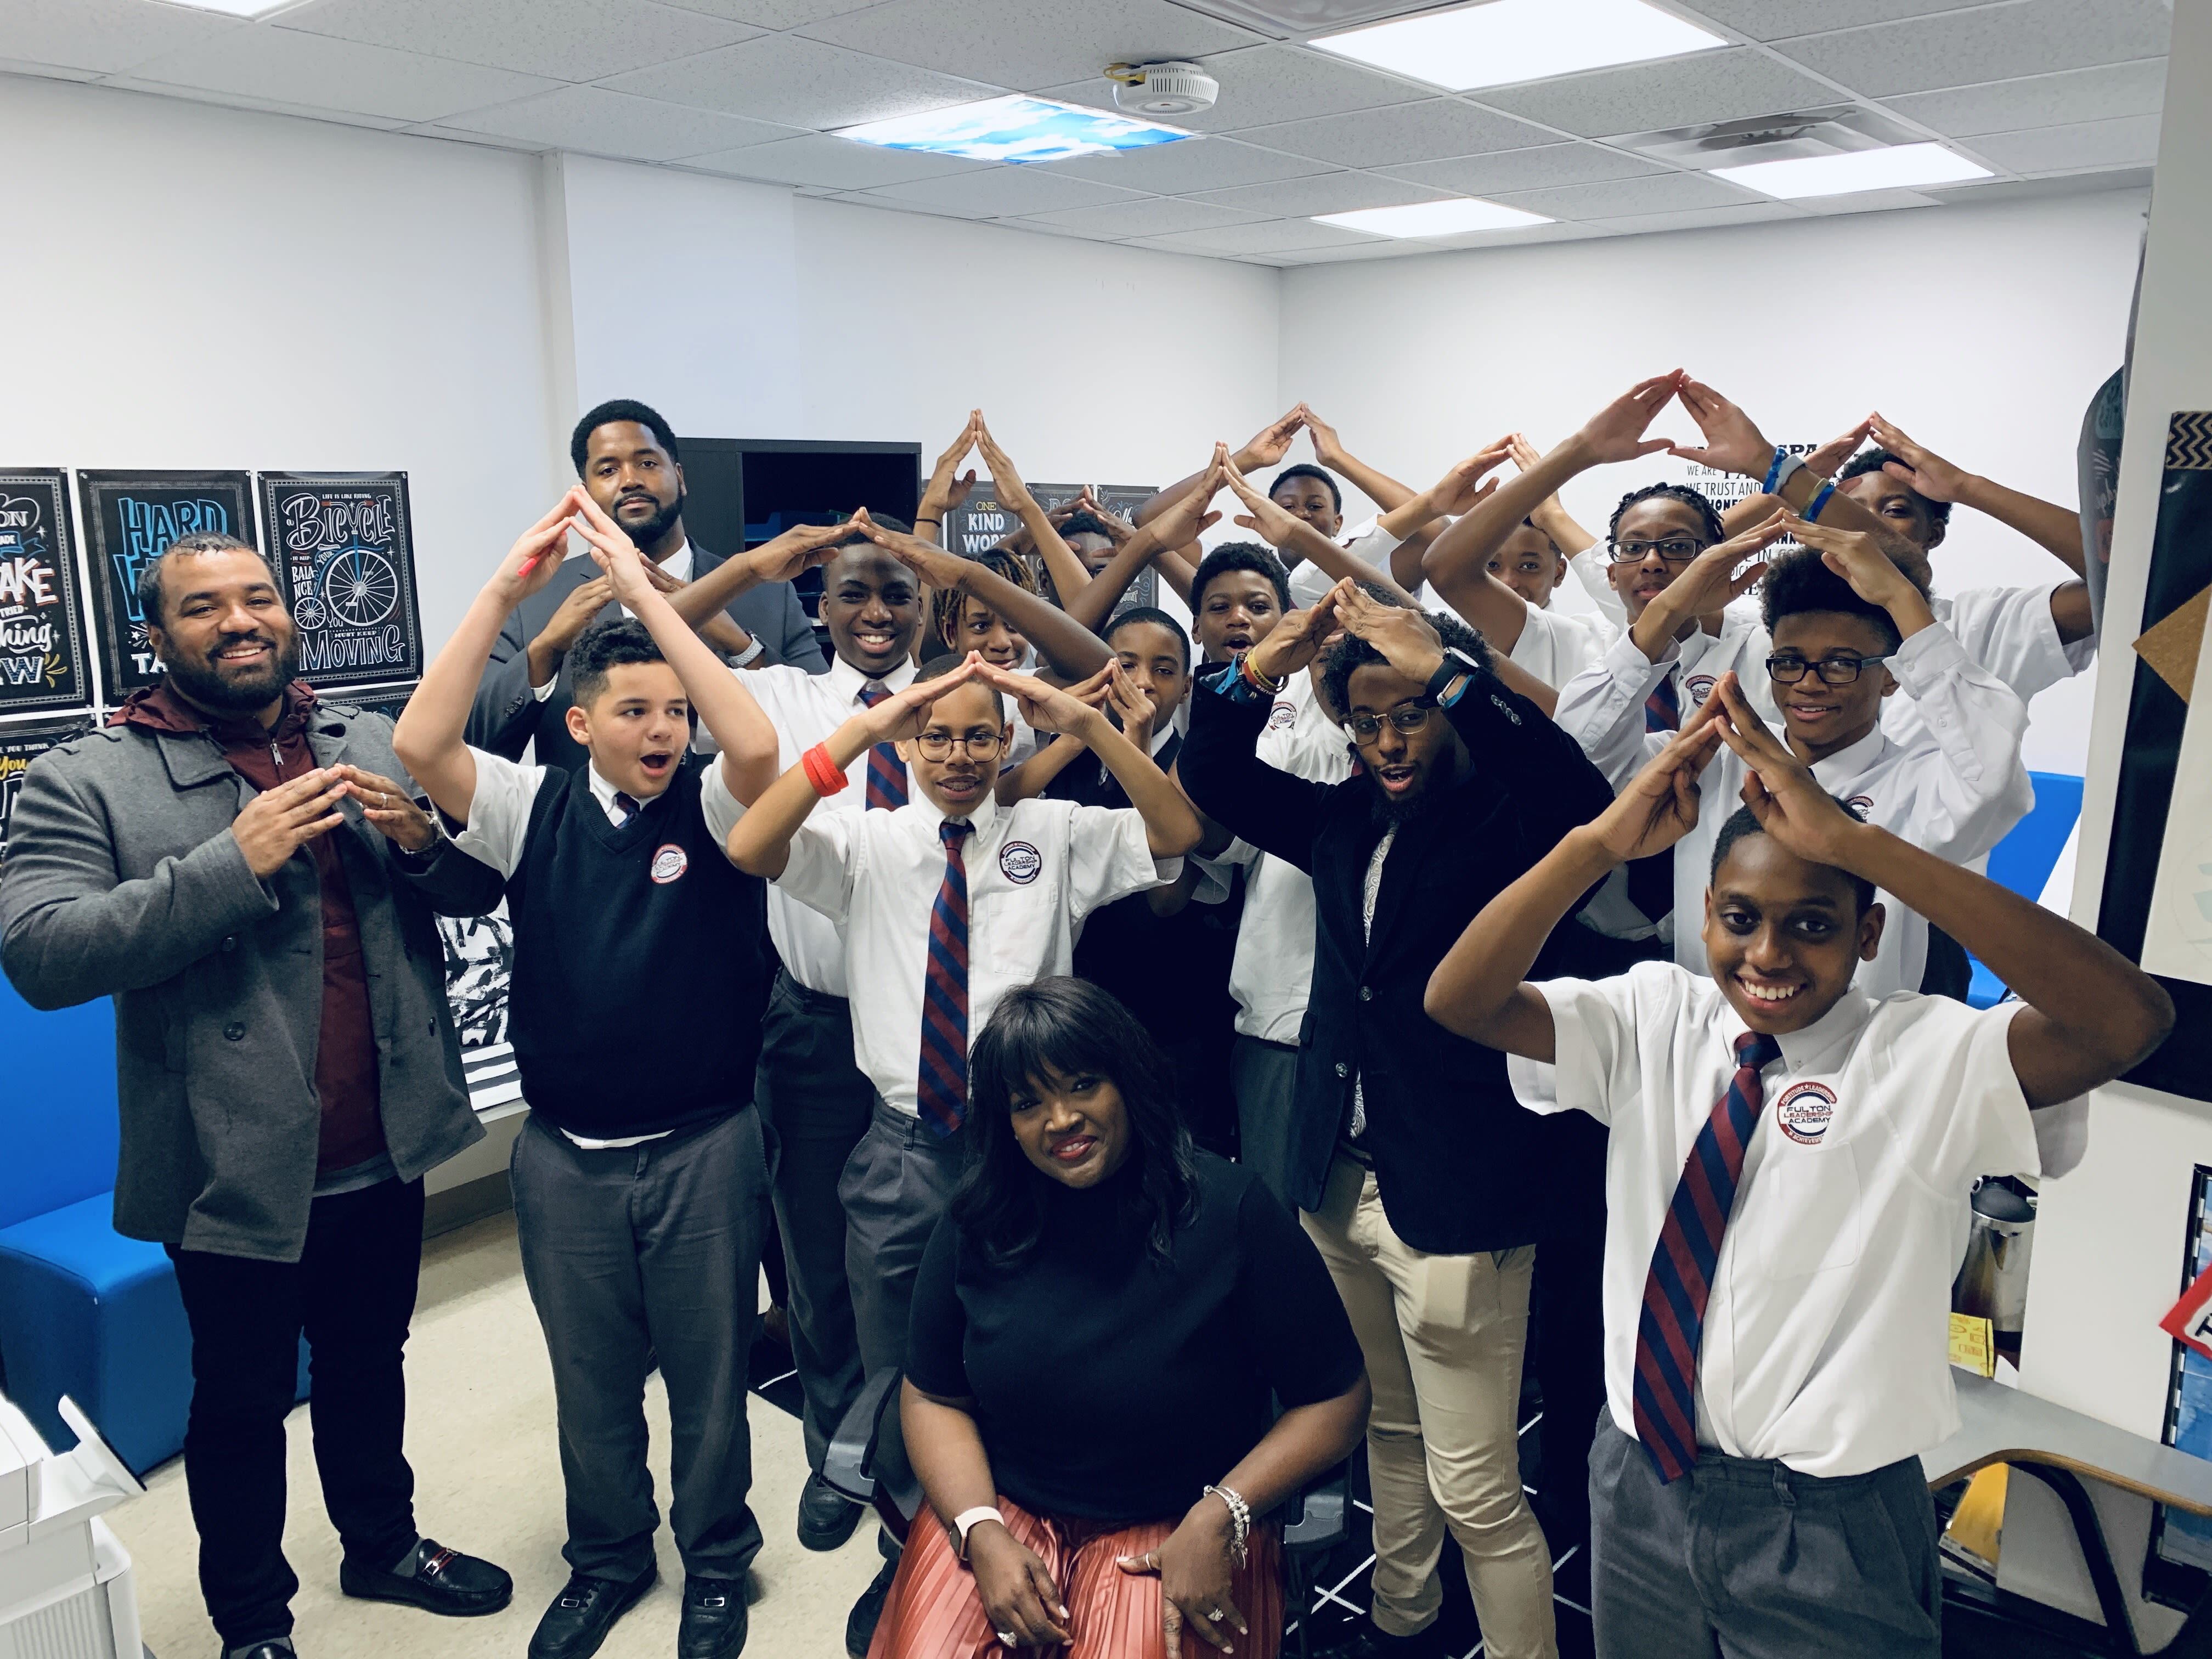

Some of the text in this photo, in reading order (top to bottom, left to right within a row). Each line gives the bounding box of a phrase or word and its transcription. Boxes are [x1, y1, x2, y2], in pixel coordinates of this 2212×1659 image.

[1687, 465, 1699, 476] WE
[1701, 465, 1717, 476] ARE
[1705, 483, 1736, 495] TRUST
[1738, 483, 1760, 495] AND
[976, 501, 997, 511] ONE
[117, 497, 228, 562] HARD
[968, 513, 1006, 532] KIND
[962, 534, 1007, 554] WOR
[317, 551, 334, 565] YOUR
[299, 624, 405, 671] MOVING
[1781, 1085, 1836, 1105] FORTITUDE LEADERSHIP
